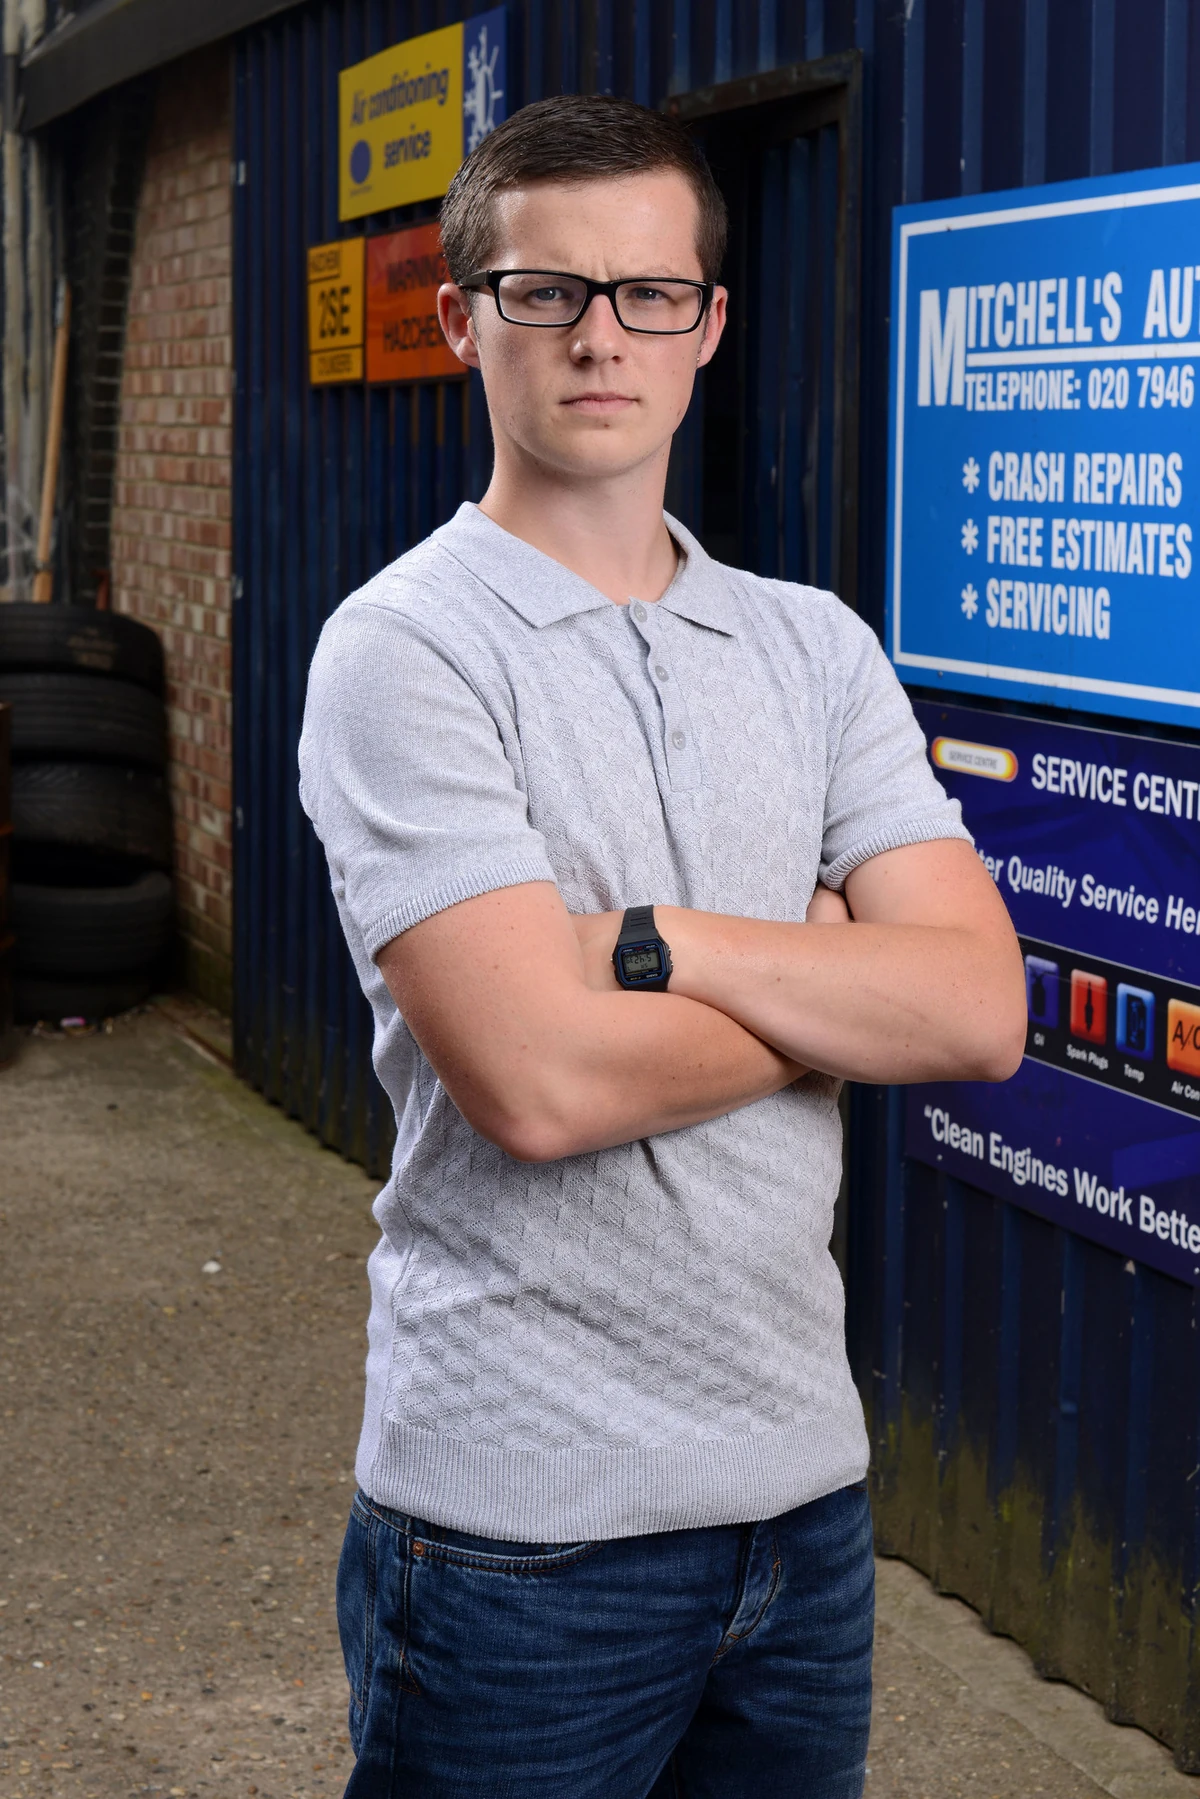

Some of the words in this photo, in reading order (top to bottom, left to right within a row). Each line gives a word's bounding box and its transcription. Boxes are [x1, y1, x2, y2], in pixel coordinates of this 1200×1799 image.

[350, 88, 367, 128] Air
[369, 61, 449, 107] conditioning
[384, 122, 431, 169] service
[917, 271, 1124, 407] MITCHELL'S
[1142, 265, 1200, 339] AU
[964, 368, 1082, 412] TELEPHONE:
[1087, 366, 1130, 410] 020
[1136, 364, 1195, 410] 7946
[987, 451, 1066, 504] CRASH
[1073, 452, 1184, 508] REPAIRS
[986, 515, 1044, 568] FREE
[1050, 518, 1194, 580] ESTIMATES
[985, 577, 1112, 640] SERVICING
[1031, 753, 1129, 807] SERVICE
[1133, 771, 1200, 823] CENT
[1007, 855, 1077, 909] Quality
[1079, 873, 1160, 924] Service
[1034, 1032, 1046, 1047] Oil
[1066, 1043, 1088, 1063] Spark
[1087, 1051, 1109, 1071] Plugs
[1123, 1063, 1145, 1084] Temp
[1171, 1080, 1184, 1096] Air
[989, 1132, 1069, 1198] Engines
[1074, 1167, 1133, 1227] Work
